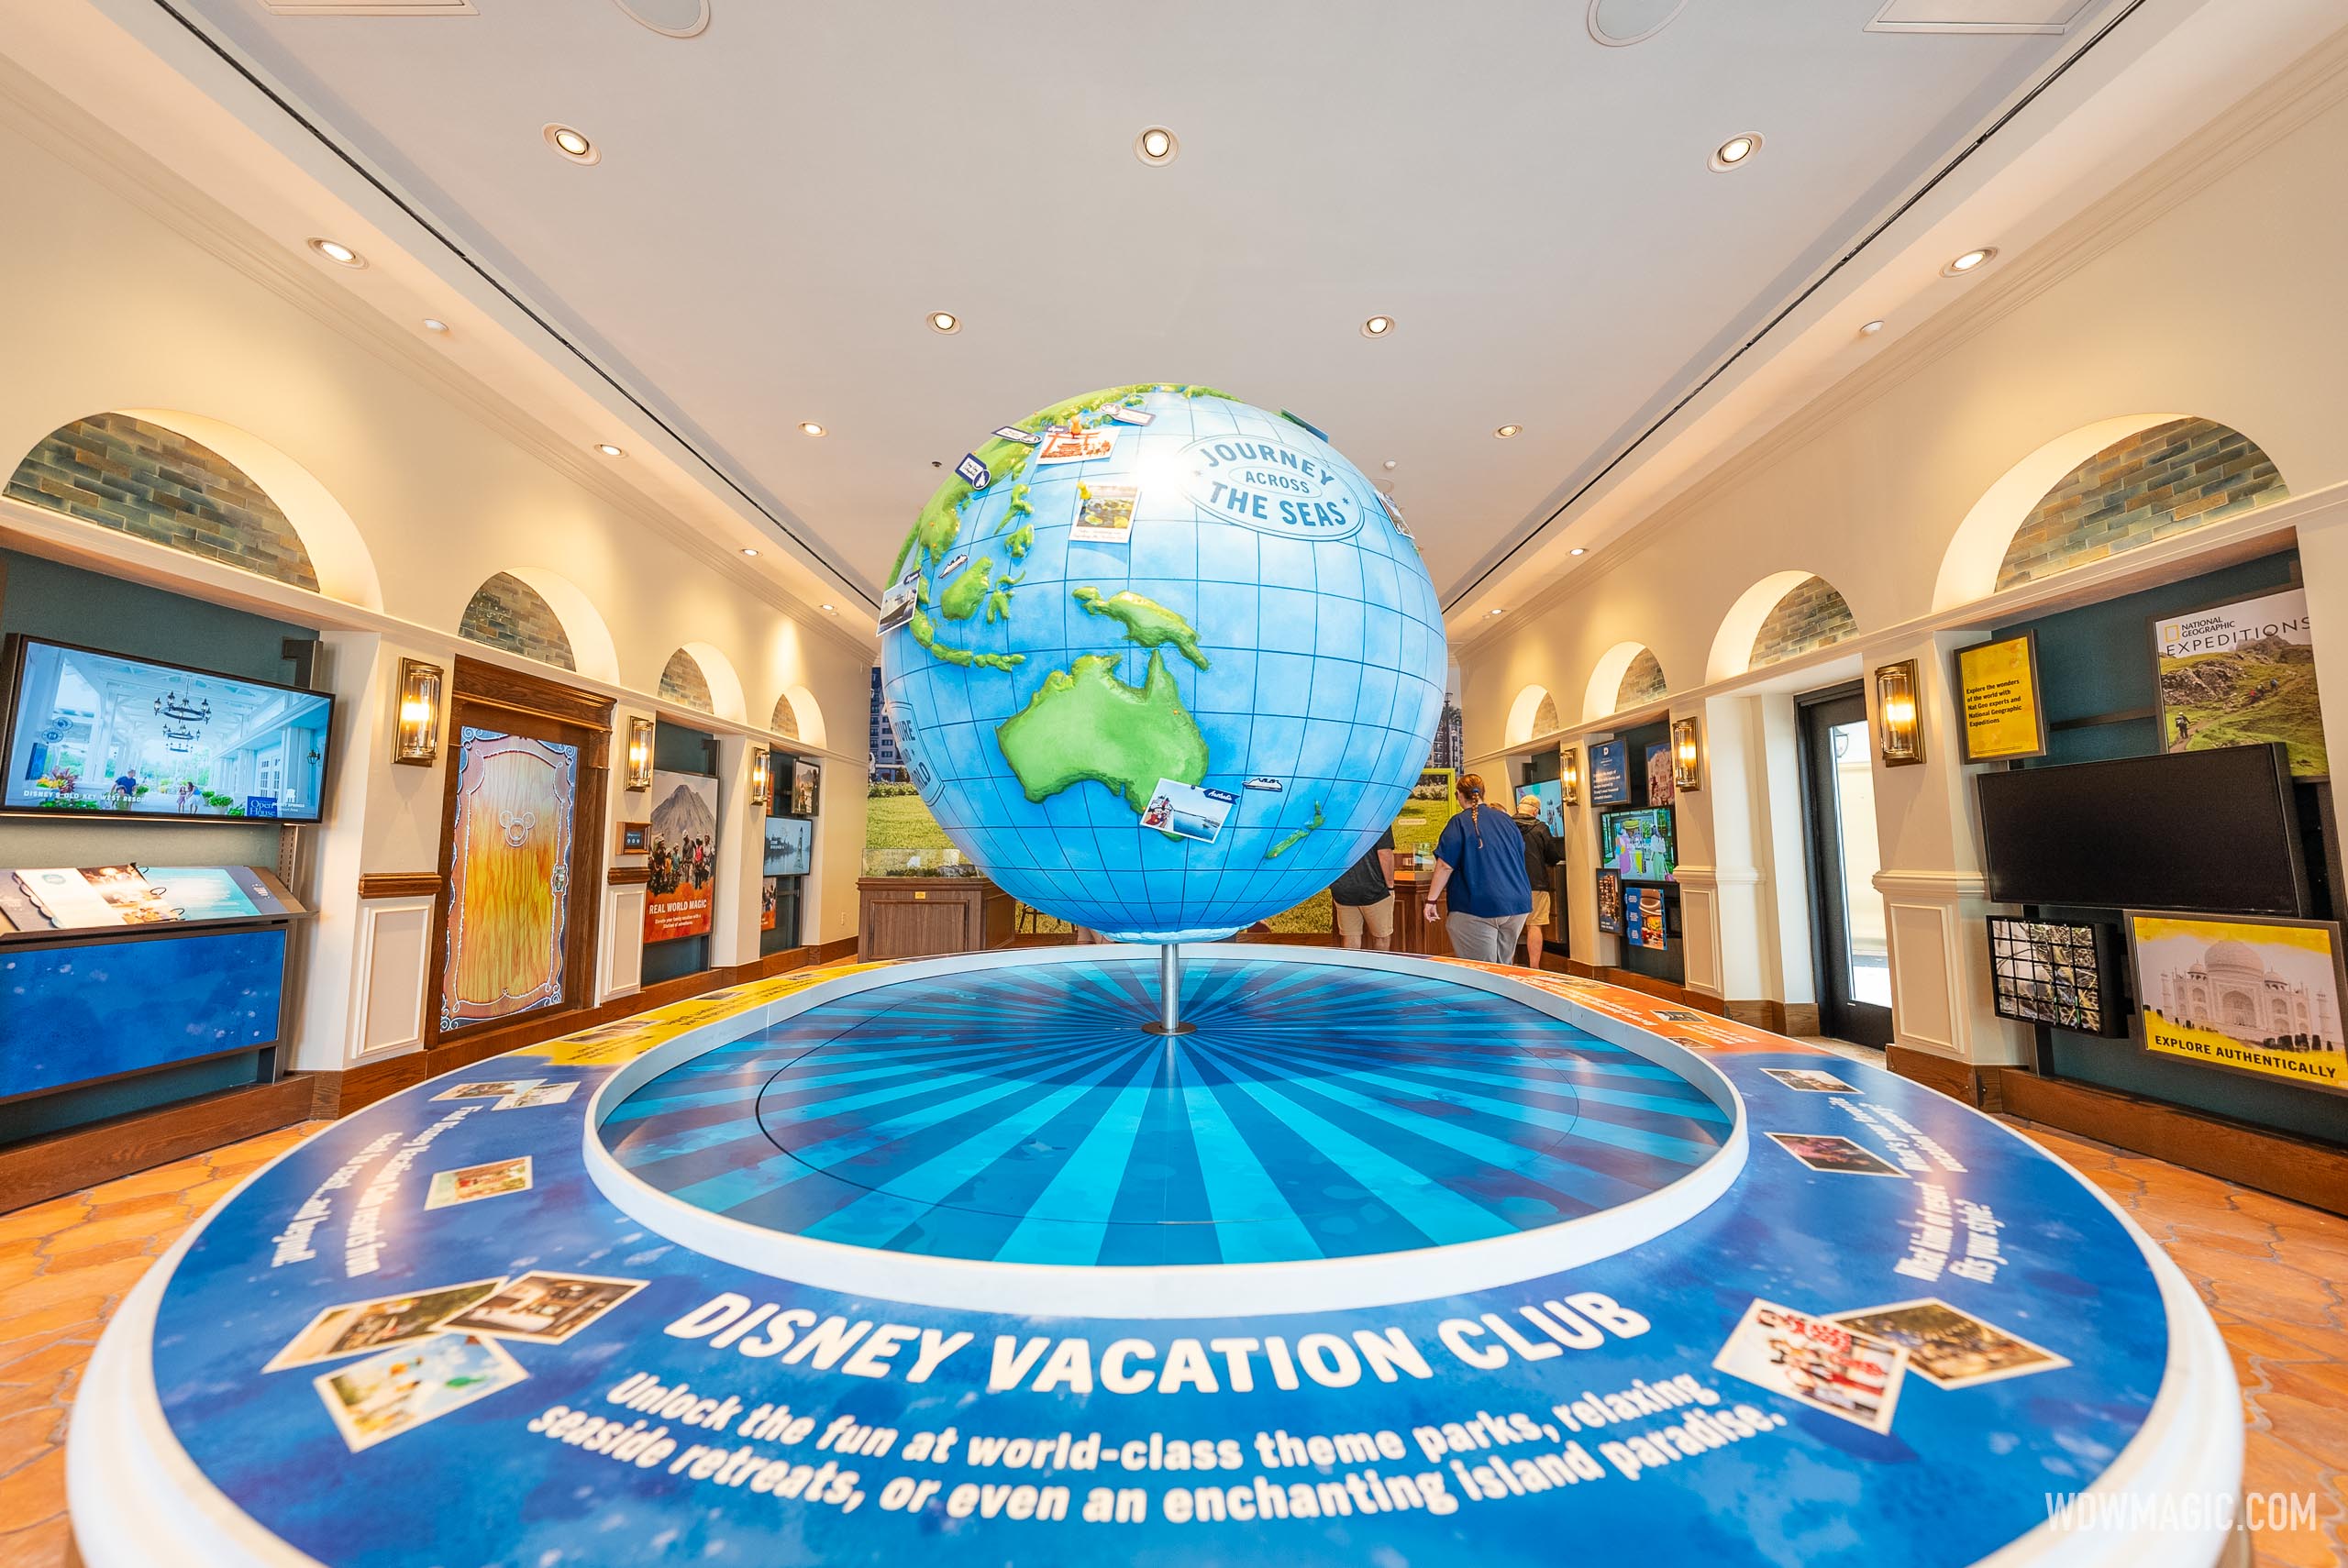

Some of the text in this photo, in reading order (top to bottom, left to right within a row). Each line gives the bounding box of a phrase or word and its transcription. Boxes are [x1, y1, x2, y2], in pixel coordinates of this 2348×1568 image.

[1200, 442, 1335, 486] JOURNEY
[1245, 470, 1310, 493] ACROSS
[1210, 480, 1346, 527] THE SEAS
[2166, 616, 2310, 657] EXPEDITIONS
[2181, 616, 2223, 631] NATIONAL
[2181, 620, 2235, 638] GEOGRAPHIC
[1966, 686, 1986, 695] Explore
[1996, 679, 2020, 688] wonders
[1989, 697, 2010, 708] experts
[1968, 705, 2022, 719] National Geographic
[1969, 718, 2000, 728] Expeditions
[23, 790, 60, 799] DISNEY'S
[250, 800, 274, 811] Open
[249, 807, 276, 815] House
[648, 899, 707, 915] REAL WORLD MAGIC
[2155, 1035, 2336, 1079] EXPLORE AUTHENTICALLY
[1913, 1181, 1953, 1215] resort
[1953, 1198, 2007, 1235] style?
[1908, 1221, 1954, 1253] kind
[1966, 1230, 2009, 1265] your
[1893, 1244, 1949, 1282] What
[663, 1291, 1651, 1394] DISNEY VACATION CLUB
[605, 1372, 1722, 1471] Unlock the fun at world-class theme parks, relaxing
[526, 1401, 1788, 1524] seaside retreats, or even an enchanting island paradise.
